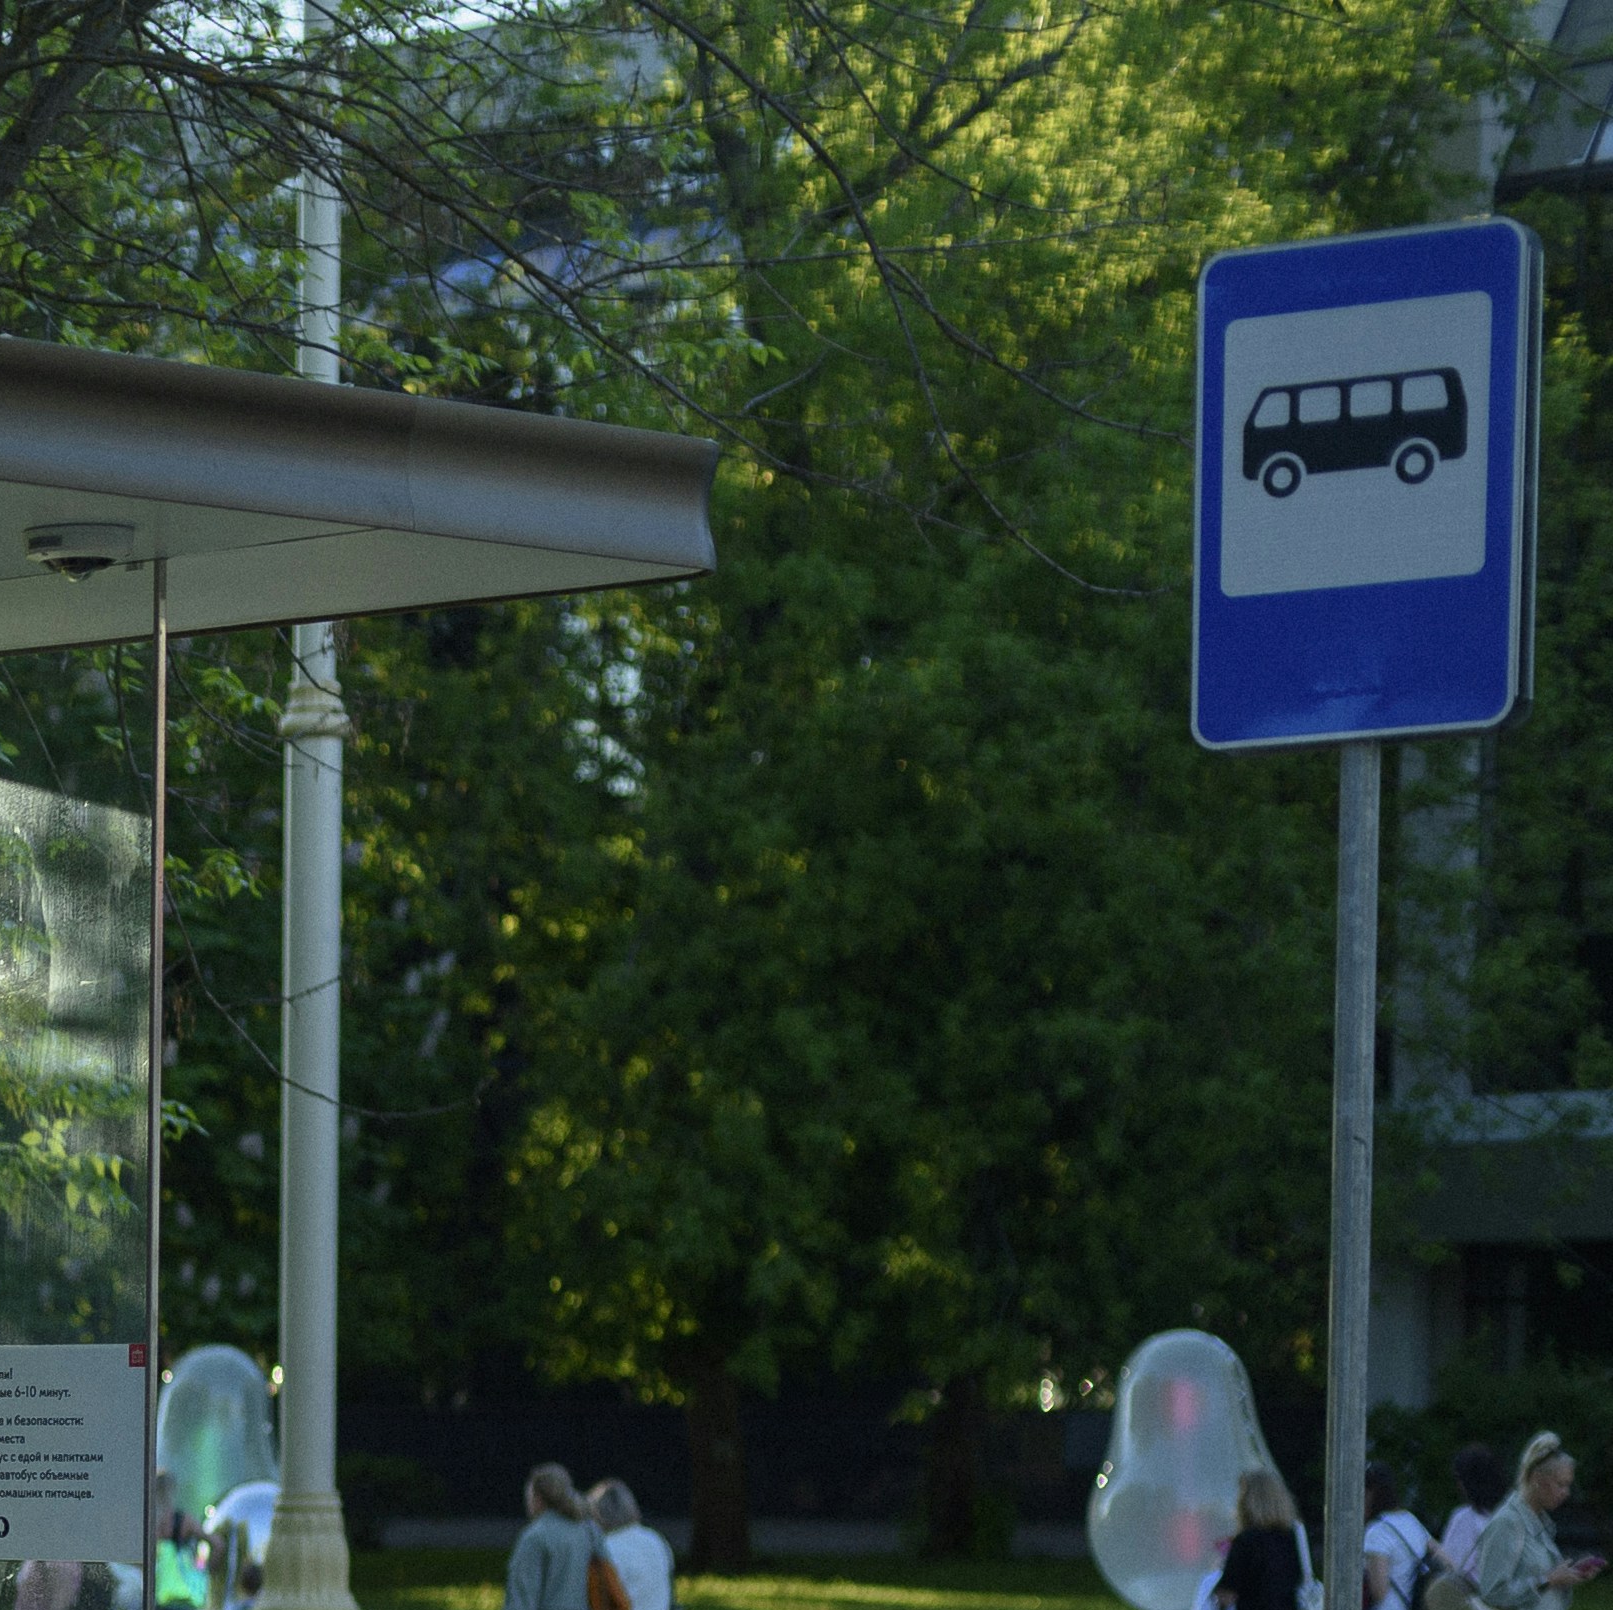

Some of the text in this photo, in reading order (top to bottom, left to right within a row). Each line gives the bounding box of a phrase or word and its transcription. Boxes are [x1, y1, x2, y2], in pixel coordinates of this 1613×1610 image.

[14, 1386, 36, 1397] 6-10
[39, 1389, 70, 1400] минут.
[14, 1415, 83, 1426] безопасности:
[10, 1454, 16, 1462] с
[18, 1452, 41, 1463] едой
[52, 1454, 103, 1462] напитками
[0, 1469, 37, 1482] автобус
[40, 1469, 89, 1480] объемные
[45, 1490, 94, 1499] питомцев.
